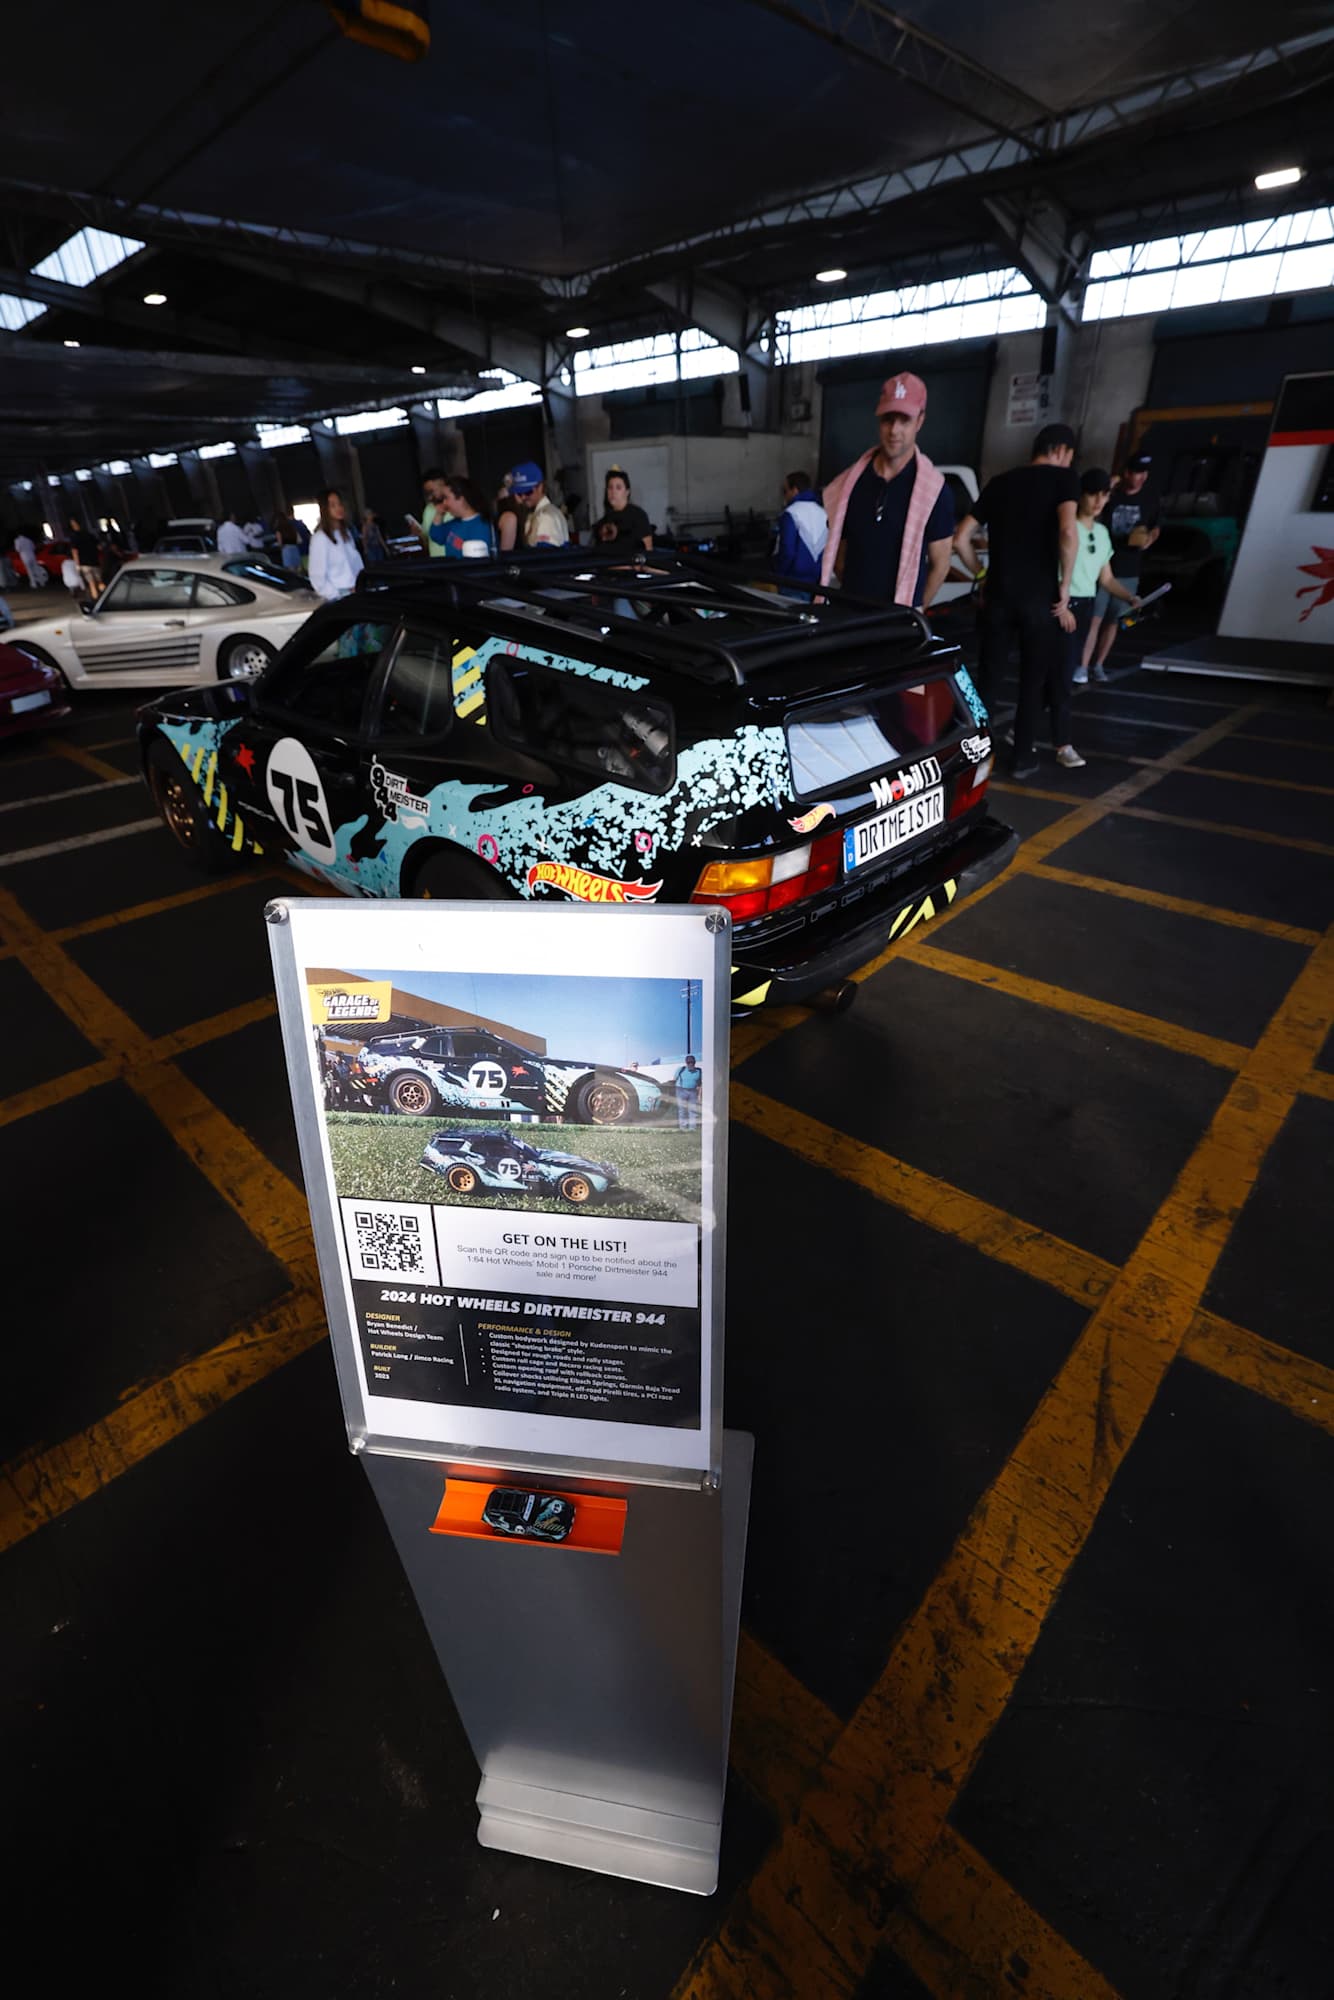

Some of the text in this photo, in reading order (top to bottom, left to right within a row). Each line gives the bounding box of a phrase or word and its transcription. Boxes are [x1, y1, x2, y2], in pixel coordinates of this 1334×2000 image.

[385, 774, 405, 792] DIRT
[870, 762, 923, 809] Mobil
[271, 769, 332, 848] 75
[390, 790, 428, 814] MEISTER
[859, 792, 941, 858] DRTMEISTR
[323, 995, 370, 1007] GARAGE
[328, 1006, 379, 1017] LEGENDS
[472, 1070, 503, 1088] 75
[500, 1164, 519, 1175] 75
[503, 1233, 627, 1253] GET ON THE LIST!
[457, 1244, 478, 1253] Scan
[494, 1248, 508, 1256] QR
[510, 1249, 530, 1257] code
[550, 1252, 567, 1261] sign
[570, 1254, 580, 1262] up
[604, 1257, 635, 1265] notified
[638, 1260, 661, 1268] about
[536, 1261, 558, 1269] Mobil
[568, 1262, 602, 1272] Porsche
[605, 1265, 650, 1276] Dirtmeister
[652, 1269, 668, 1277] 944
[555, 1272, 570, 1280] and
[366, 1312, 400, 1321] DESIGNER
[380, 1290, 666, 1326] 2024 HOT WHEELS DIRTMEISTER 944
[405, 1332, 426, 1340] Design
[478, 1323, 533, 1334] PERFORMANCE
[489, 1332, 513, 1340] Custom
